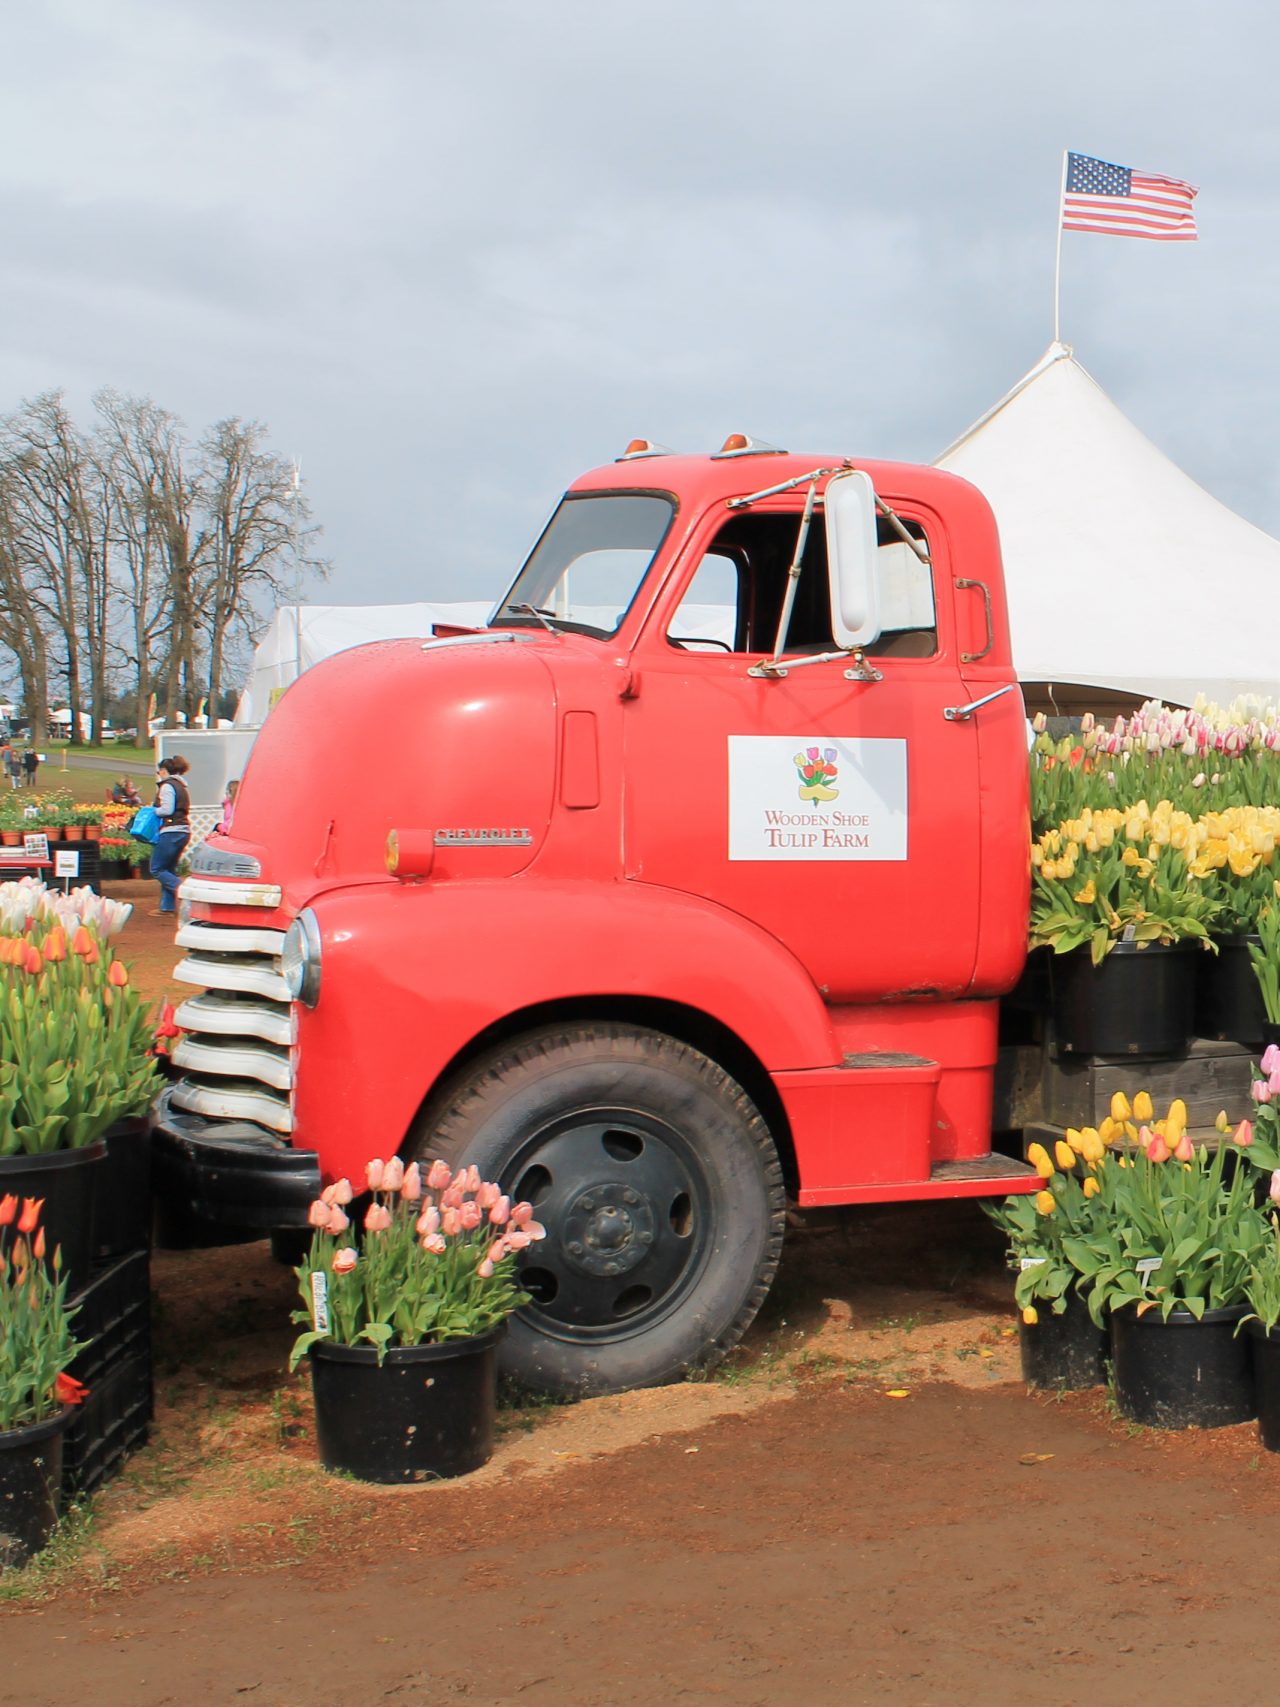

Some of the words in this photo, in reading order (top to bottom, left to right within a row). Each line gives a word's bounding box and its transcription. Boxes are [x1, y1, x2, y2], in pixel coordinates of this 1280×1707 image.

[765, 810, 829, 826] WOODEN
[832, 811, 870, 826] SHOE
[434, 828, 530, 840] CHEVROLET
[764, 828, 818, 847] TULIP
[822, 828, 870, 847] FARM
